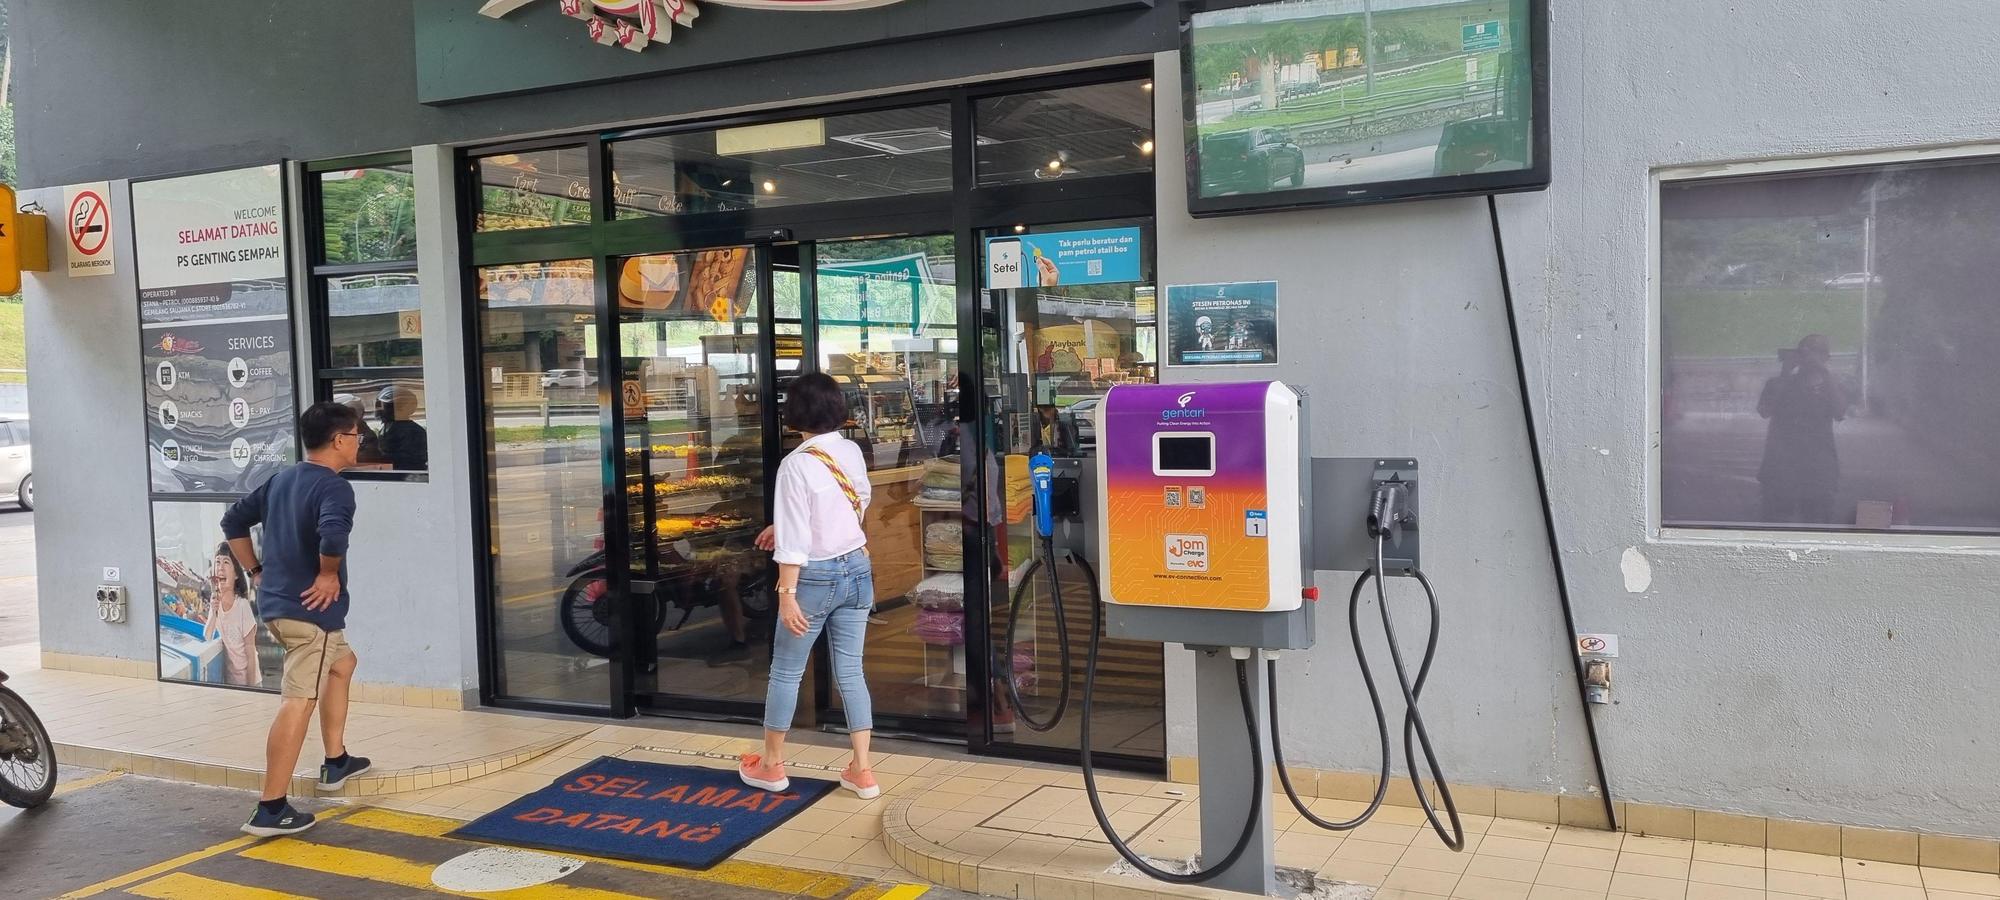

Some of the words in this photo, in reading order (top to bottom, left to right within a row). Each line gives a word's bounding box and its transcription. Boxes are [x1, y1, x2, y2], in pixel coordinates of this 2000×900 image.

[513, 173, 538, 192] Tart
[233, 206, 277, 221] WELCOME
[178, 226, 228, 244] SELAMAT
[230, 221, 278, 239] DATANG
[1059, 239, 1071, 247] Tak
[1072, 239, 1091, 248] perlu
[1092, 237, 1118, 246] beratur
[177, 255, 189, 267] PS
[191, 250, 237, 267] GENTING
[238, 246, 279, 263] SEMPAH
[1059, 250, 1074, 258] pam
[1075, 248, 1097, 257] petrol
[71, 261, 92, 269] DILARANG
[91, 260, 112, 268] MEROKOK
[993, 262, 1018, 274] Setel
[142, 290, 168, 298] OPERATED
[228, 336, 275, 350] SERVICES
[1051, 339, 1087, 350] Maybank
[178, 371, 190, 379] ATM
[250, 367, 273, 376] COFFEE
[180, 411, 203, 419] SNACKS
[259, 407, 271, 416] PAY
[1162, 408, 1205, 421] gentari
[182, 444, 203, 452] TOUCH
[253, 443, 274, 452] PHONE
[253, 453, 286, 463] CHARGING
[1253, 523, 1259, 534] 1
[1169, 539, 1204, 557] Jom
[1184, 550, 1205, 558] Charge
[1187, 560, 1205, 568] evc
[1153, 573, 1222, 581] www.ev-connection.com
[564, 774, 801, 813] SELAMAT
[513, 806, 726, 843] DATANG
